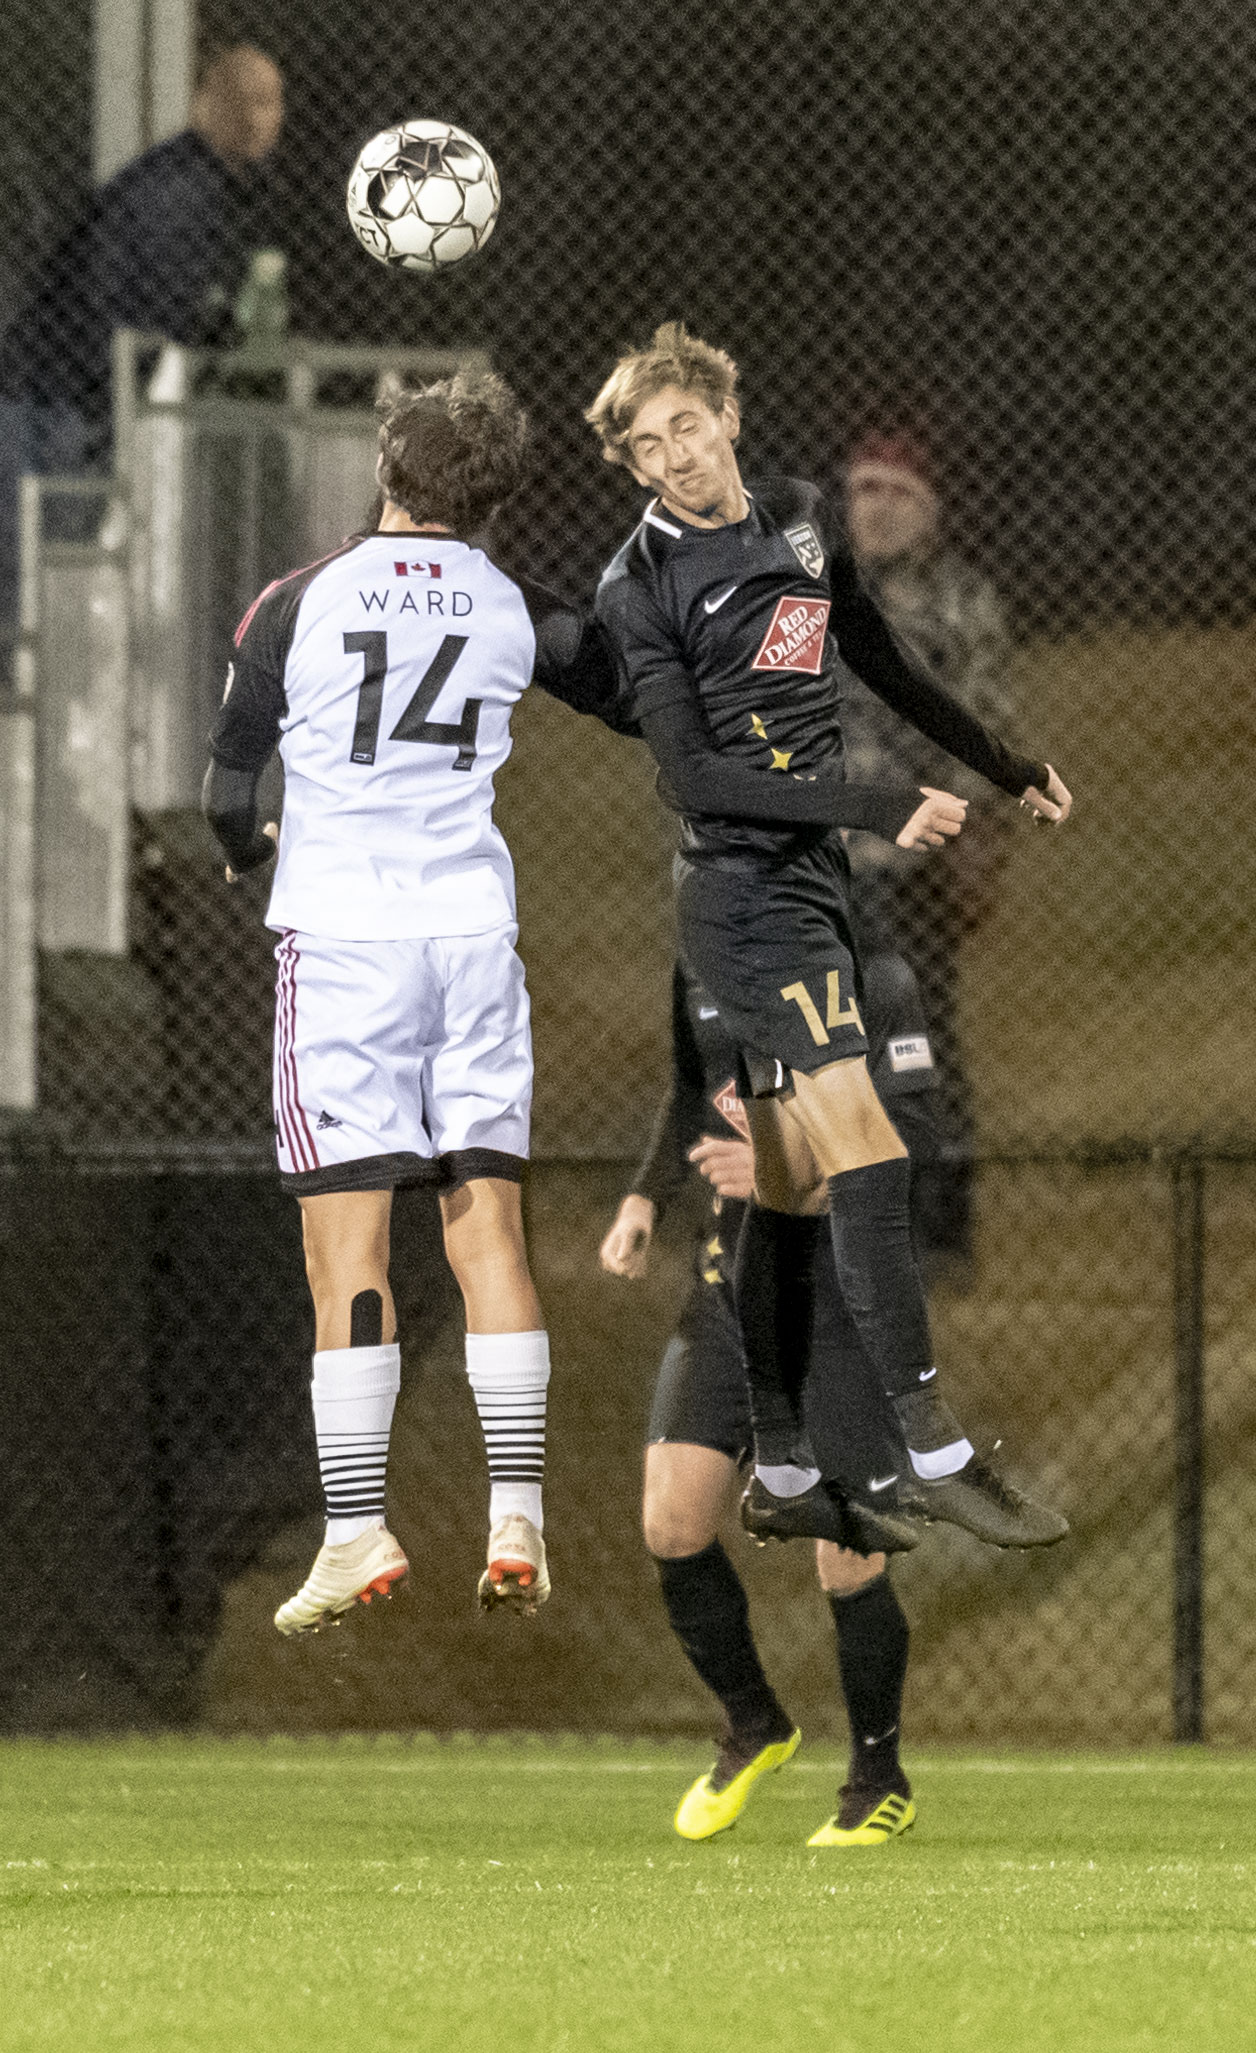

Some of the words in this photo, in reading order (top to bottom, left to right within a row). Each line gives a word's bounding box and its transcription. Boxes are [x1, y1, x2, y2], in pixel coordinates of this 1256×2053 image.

[359, 589, 473, 616] WARD
[778, 606, 808, 637] RED
[764, 607, 826, 665] DIAMOND
[343, 630, 485, 772] 14
[780, 969, 865, 1047] 14
